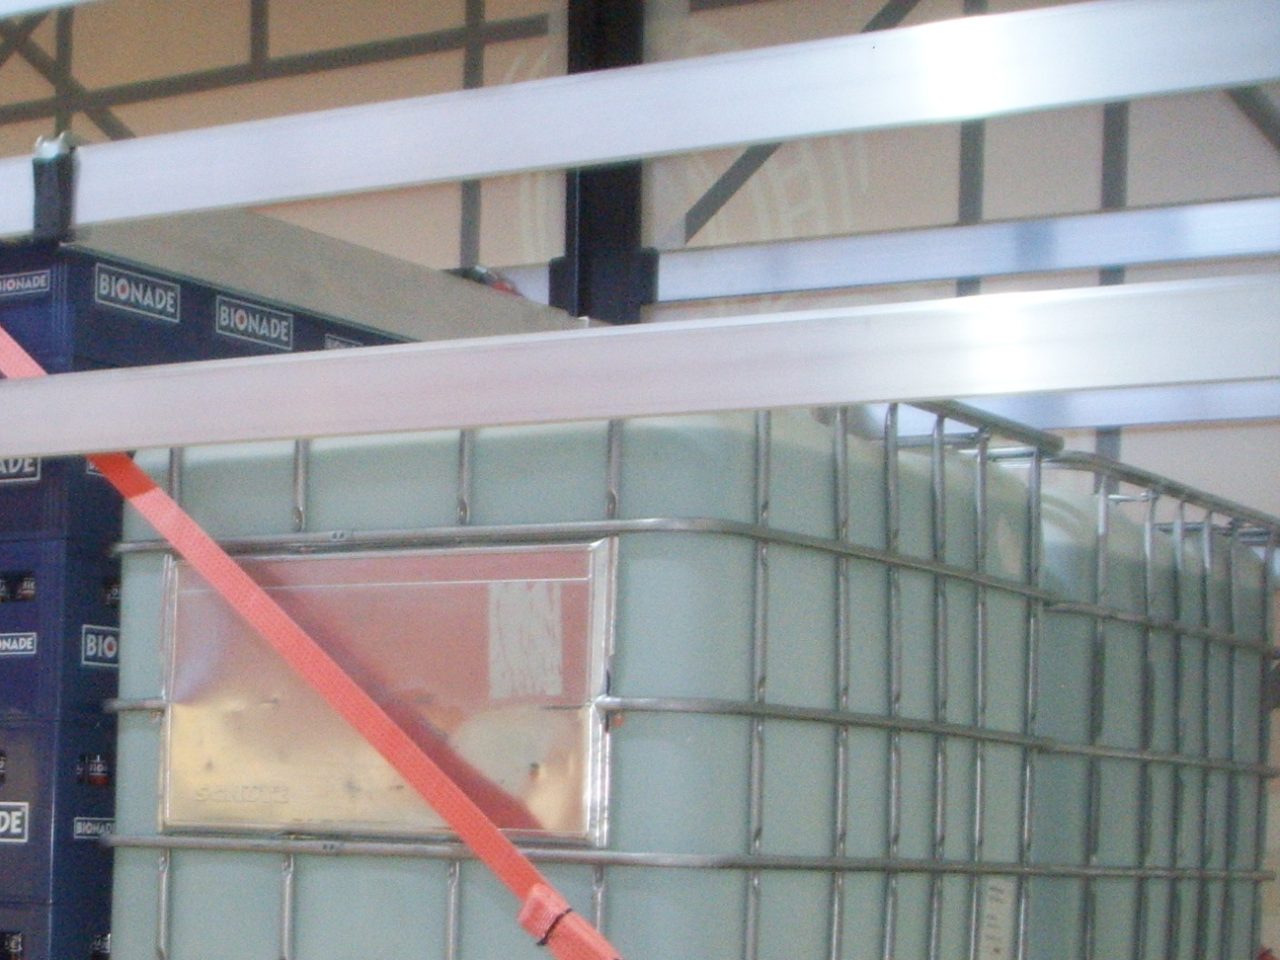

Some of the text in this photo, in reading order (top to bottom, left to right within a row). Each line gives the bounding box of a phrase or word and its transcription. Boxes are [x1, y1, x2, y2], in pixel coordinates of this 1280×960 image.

[99, 273, 175, 313] BIONADE
[220, 305, 289, 342] BIONADE
[76, 820, 115, 834] BIONAD
